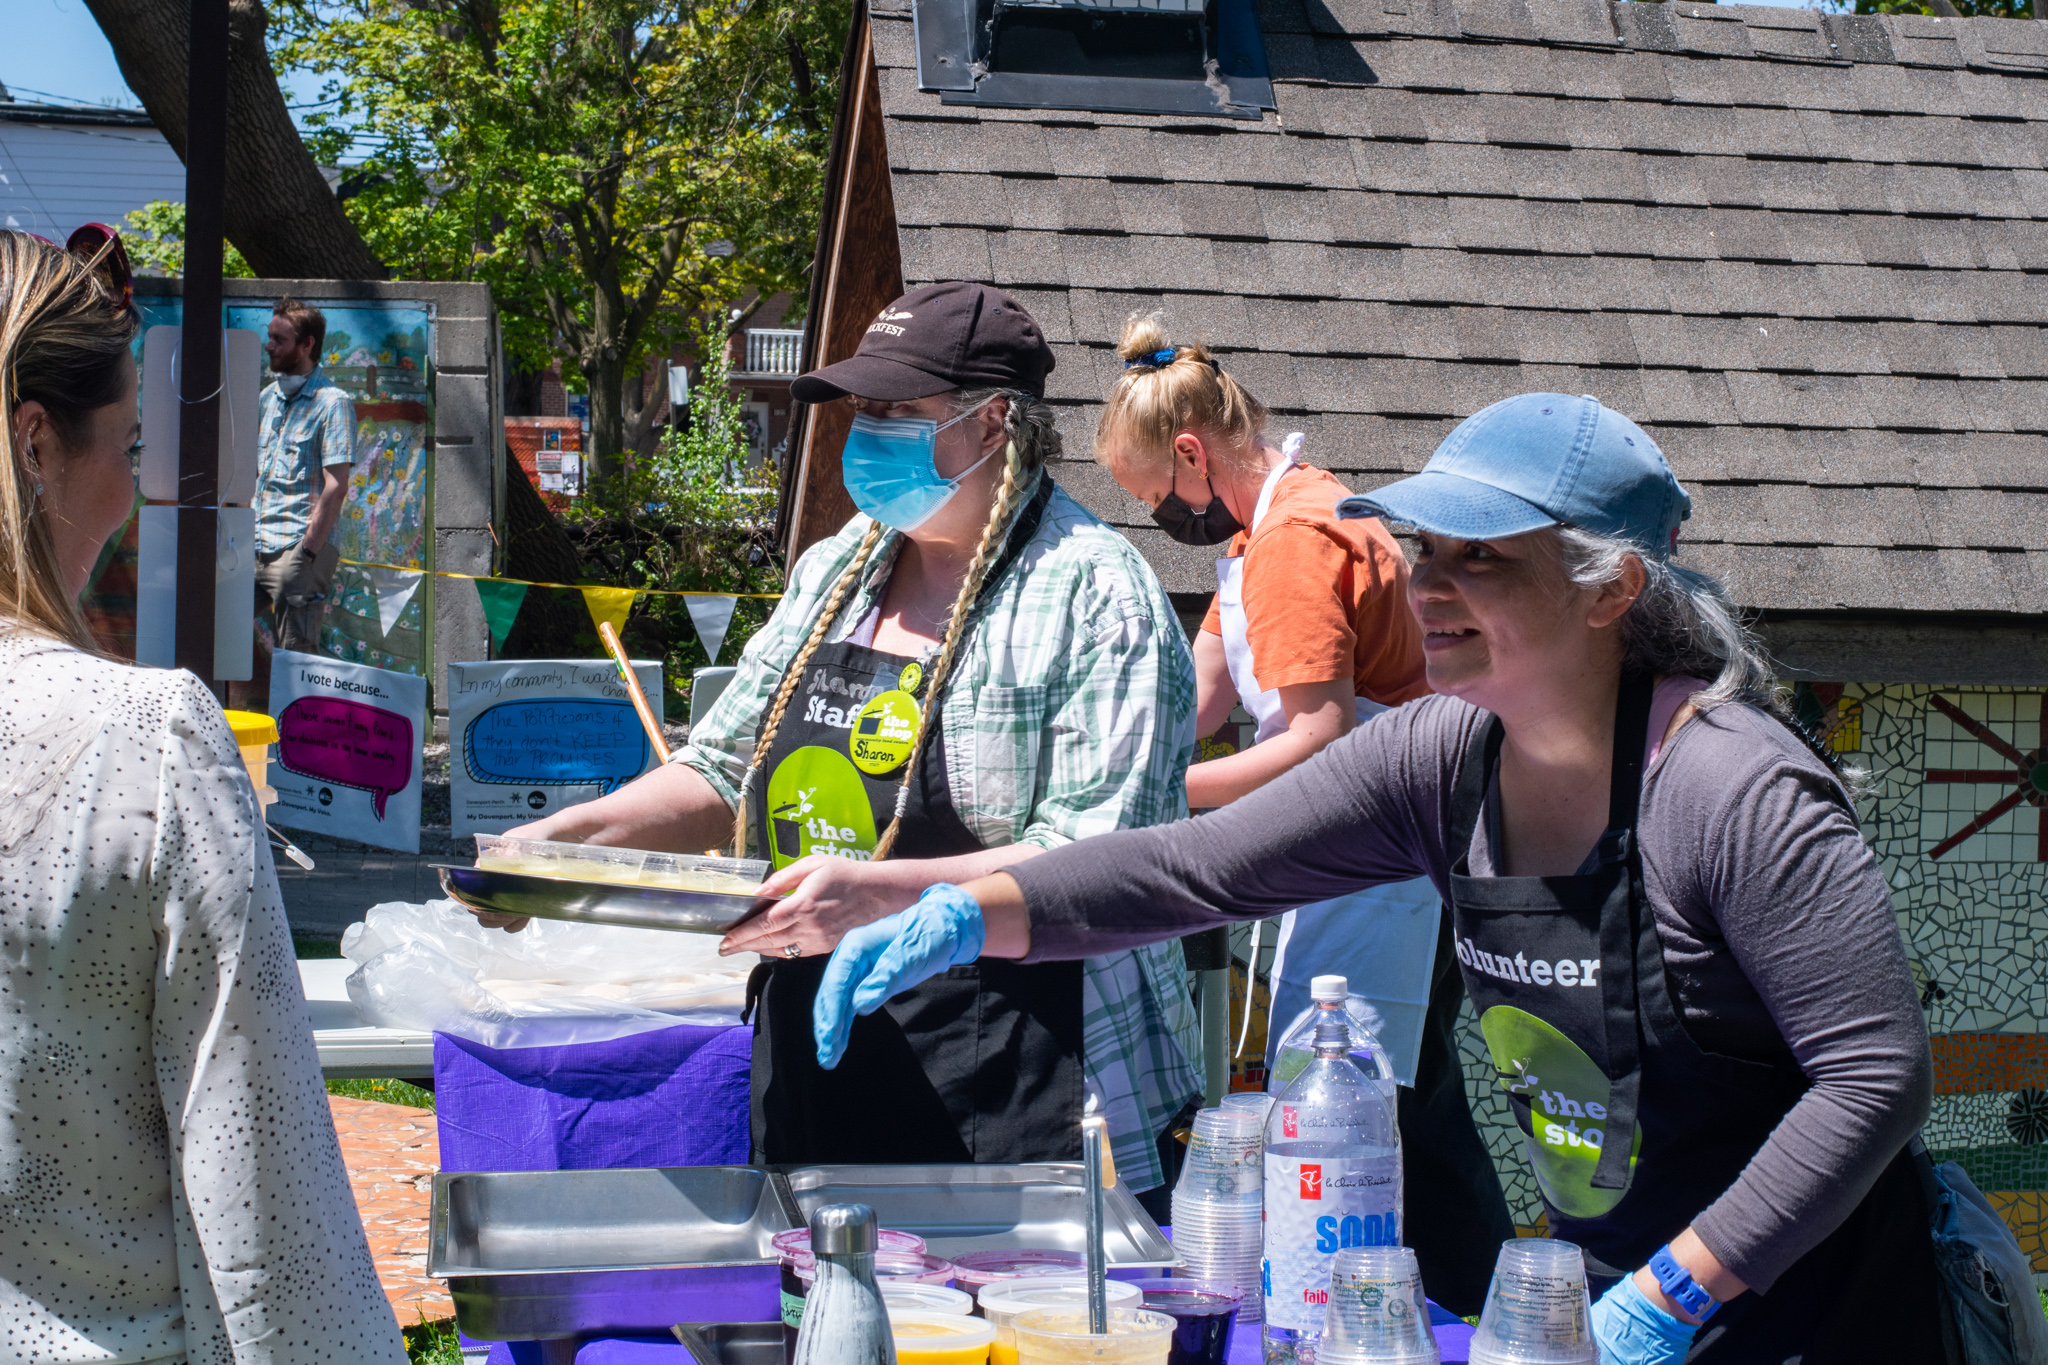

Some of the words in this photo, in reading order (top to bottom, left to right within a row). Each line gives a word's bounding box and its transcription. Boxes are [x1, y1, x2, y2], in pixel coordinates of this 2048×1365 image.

[301, 670, 305, 682] I
[307, 673, 332, 687] vote
[334, 676, 389, 699] because...
[457, 666, 478, 694] In
[482, 677, 502, 697] my
[569, 665, 580, 685] I
[613, 710, 625, 728] if
[883, 715, 910, 728] the
[482, 733, 513, 753] they
[572, 731, 626, 749] KEEP
[880, 727, 913, 741] stop
[531, 752, 616, 770] PROMISES
[854, 740, 896, 762] Sharon
[478, 813, 515, 821] Davenport.
[806, 817, 857, 843] the
[1454, 927, 1601, 987] olunteer
[1539, 1089, 1608, 1120] the
[1544, 1119, 1606, 1149] sto
[1316, 1212, 1397, 1254] SODA
[1303, 1288, 1328, 1304] faib
